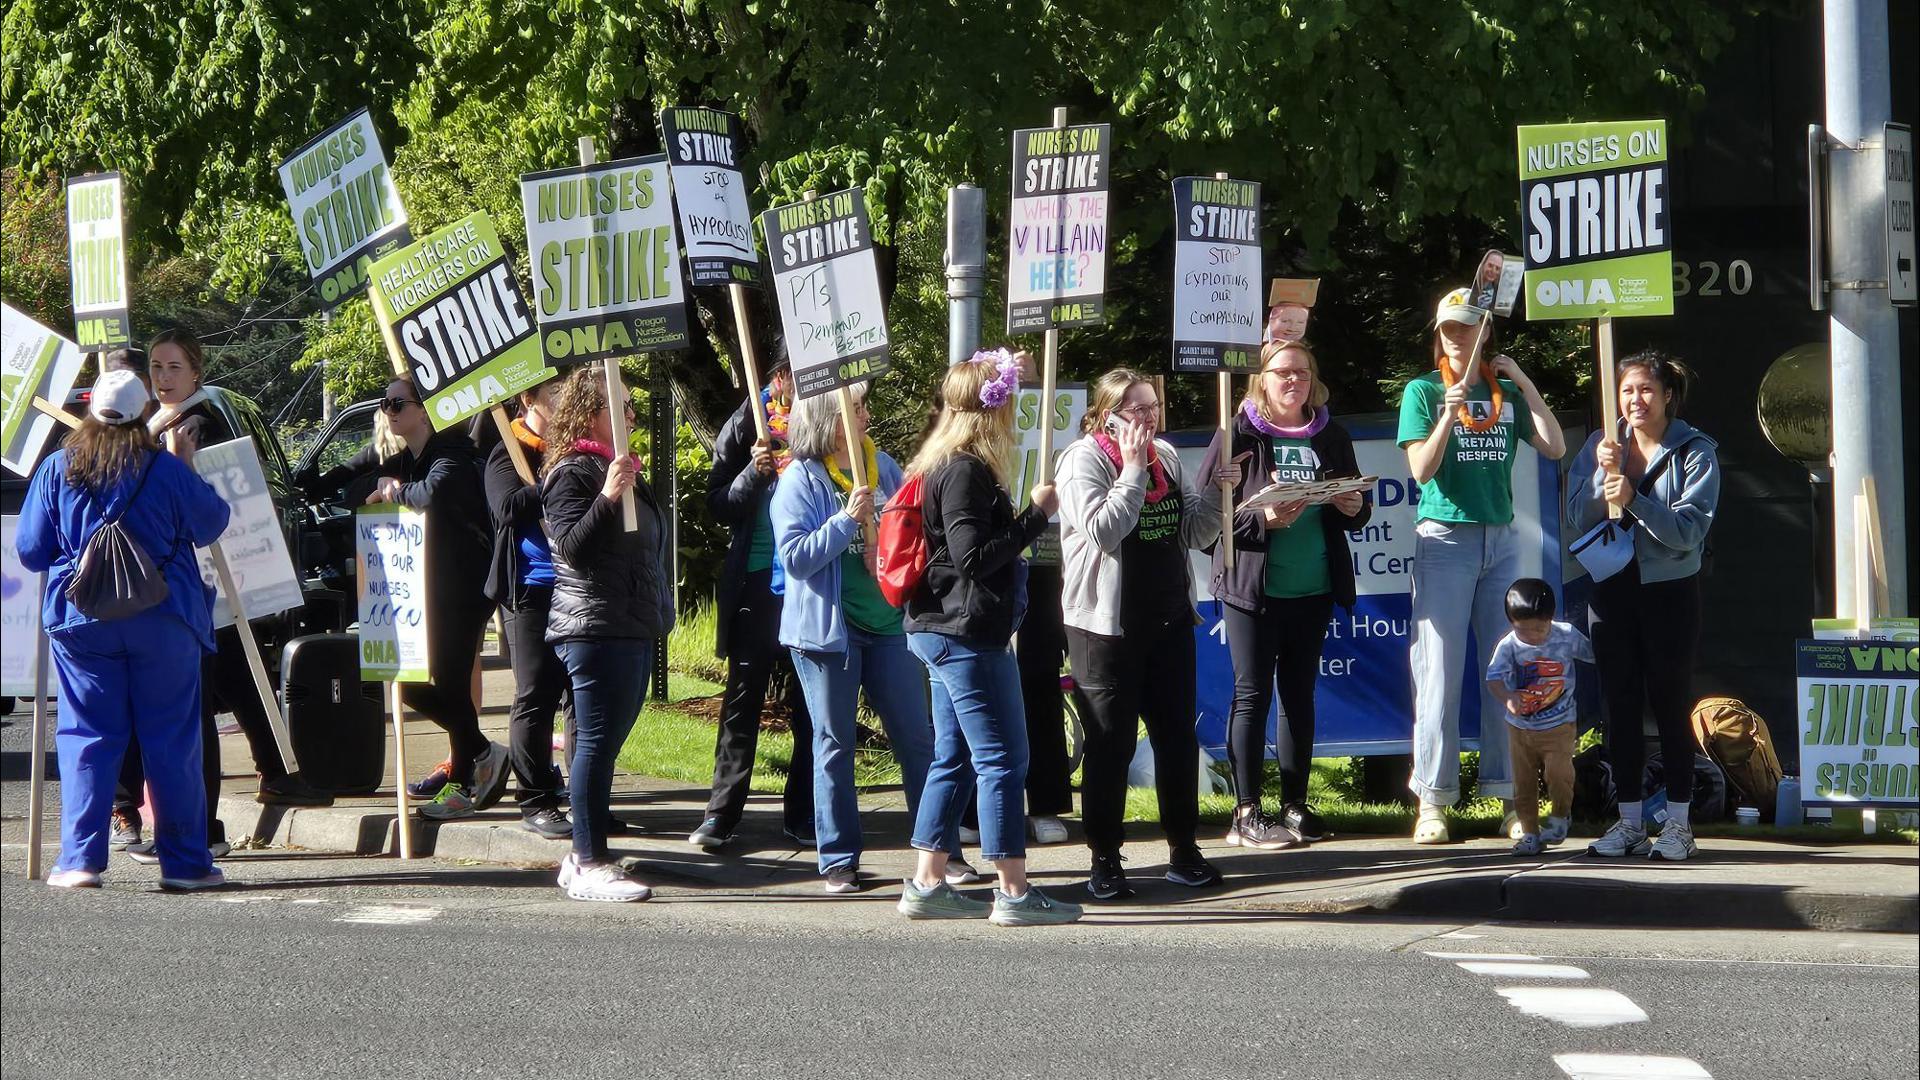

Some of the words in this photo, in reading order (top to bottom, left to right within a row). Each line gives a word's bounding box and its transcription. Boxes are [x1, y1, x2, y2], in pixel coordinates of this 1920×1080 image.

[678, 132, 735, 166] STRIKE
[1027, 129, 1080, 156] NURSES
[1080, 127, 1100, 152] ON
[1528, 140, 1620, 173] NURSES
[1627, 129, 1660, 159] ON
[288, 121, 366, 197] NURSES
[1024, 155, 1100, 193] STRIKE
[70, 182, 114, 225] NURSES
[538, 168, 655, 223] NURSES
[1079, 197, 1104, 220] THE
[1191, 180, 1239, 205] NURSES
[1240, 186, 1255, 206] ON
[302, 161, 395, 270] STRIKE
[779, 198, 832, 233] NURSES
[833, 193, 854, 217] ON
[1190, 205, 1256, 241] STRIKE
[1529, 168, 1664, 264] STRIKE
[782, 217, 860, 267] STRIKE
[1015, 223, 1103, 256] VILLAIN
[1208, 246, 1241, 265] STOP
[73, 236, 122, 307] STRIKE
[379, 219, 478, 297] HEALTHCARE
[541, 225, 671, 317] STRIKE
[1030, 252, 1091, 291] HERE?
[320, 254, 373, 302] ONA
[389, 255, 465, 317] WORKERS
[465, 240, 491, 272] ON
[788, 264, 831, 317] PTs
[1535, 278, 1616, 307] ONA
[401, 262, 529, 392] STRIKE
[634, 314, 668, 328] Oregon
[1051, 304, 1083, 322] ONA
[77, 319, 108, 347] ONA
[545, 320, 634, 359] ONA
[635, 325, 666, 337] Nurses
[636, 331, 686, 347] Association
[838, 359, 871, 381] ONA
[1223, 350, 1248, 367] ONA
[435, 373, 508, 422] ONA
[1457, 450, 1509, 462] RESPECT
[1459, 436, 1507, 449] RETAIN
[359, 522, 380, 542] WE
[386, 521, 423, 553] STAND
[1348, 520, 1393, 543] ent
[391, 553, 415, 572] OUR
[1368, 552, 1415, 575] Cen
[368, 580, 411, 600] NURSES
[1351, 615, 1407, 638] Hou
[363, 640, 398, 664] ONA
[1319, 655, 1356, 677] ter
